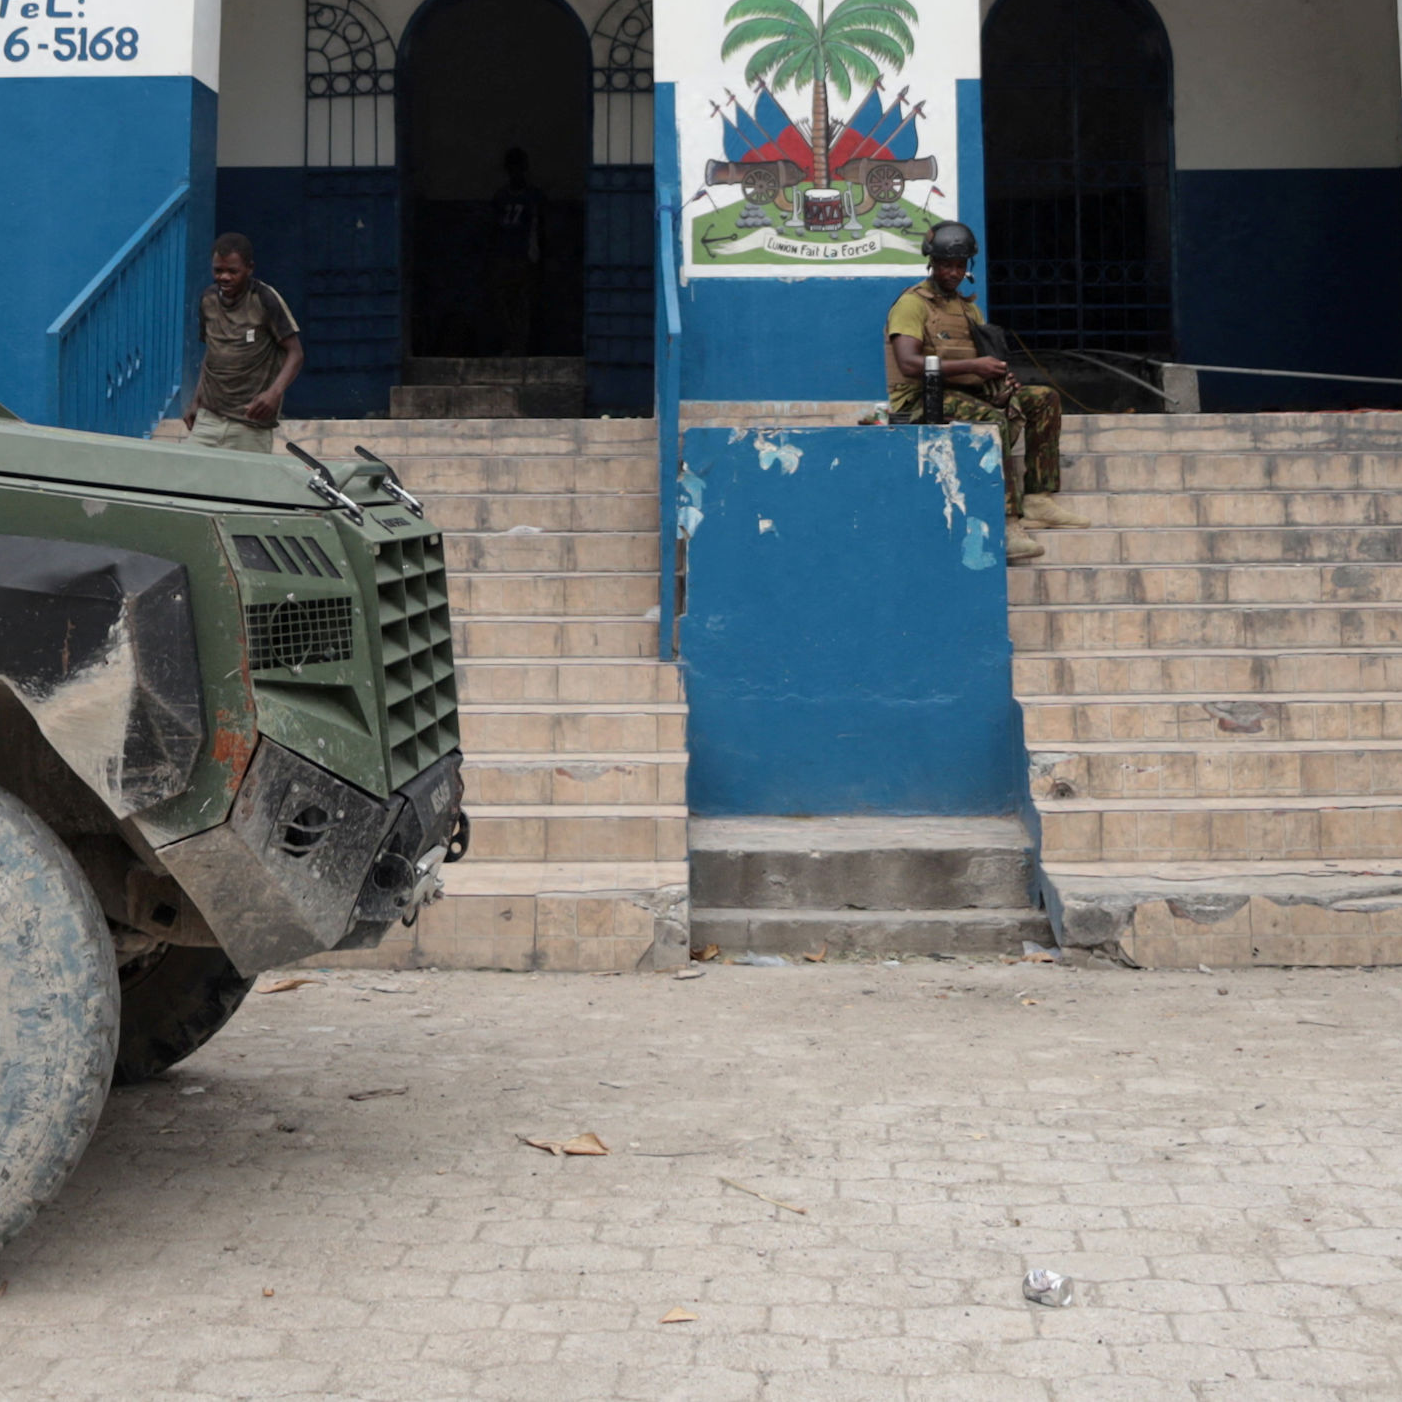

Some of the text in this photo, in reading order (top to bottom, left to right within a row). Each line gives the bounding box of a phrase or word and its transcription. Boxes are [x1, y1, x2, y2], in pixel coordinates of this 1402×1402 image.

[800, 244, 820, 257] Fait
[823, 245, 838, 258] La
[841, 240, 877, 257] Force
